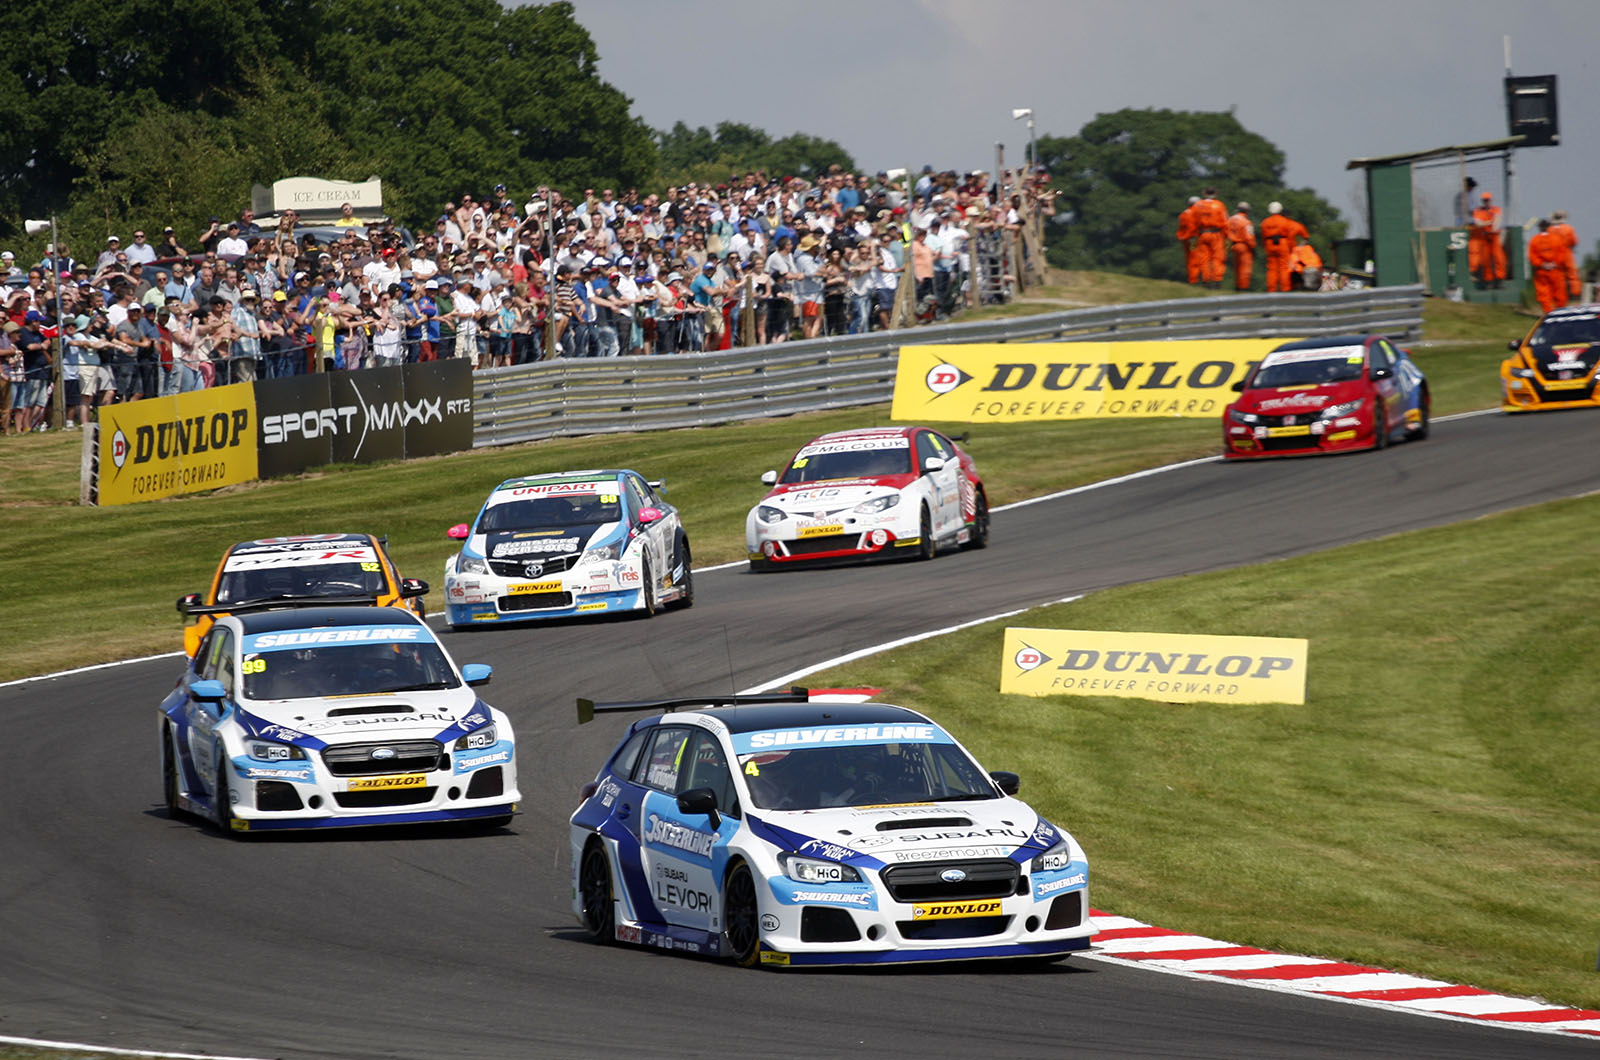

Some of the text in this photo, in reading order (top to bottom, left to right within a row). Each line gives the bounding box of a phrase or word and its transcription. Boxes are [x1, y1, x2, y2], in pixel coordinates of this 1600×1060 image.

[294, 190, 361, 203] ICE CREAM
[971, 399, 1217, 416] FOREVER FORWARD
[263, 396, 471, 444] SPORT MAXX RT2
[133, 408, 248, 464] DUNLOP
[818, 440, 906, 453] MG.CO.UK
[132, 462, 226, 494] FOREVER FORWARD
[512, 483, 598, 496] UNIPART
[796, 517, 840, 529] MG.CO.UK
[804, 526, 844, 535] DUNLOP
[232, 550, 369, 567] TYPE R
[360, 562, 381, 572] 52
[621, 570, 640, 581] reis
[516, 583, 561, 592] DUNLOP
[254, 628, 421, 649] SILVERLINE
[242, 658, 267, 675] 99
[1057, 649, 1294, 679] DUNLOP
[1051, 677, 1239, 696] FOREVER FORWARD
[342, 714, 456, 726] SUBARU
[468, 736, 484, 747] HiQ
[750, 723, 935, 748] SILVERLINE
[269, 749, 288, 758] HiQ
[745, 760, 760, 777] 4
[899, 828, 1029, 842] SUBARU
[820, 843, 855, 858] ADRIAN
[822, 850, 842, 861] FLUX
[896, 846, 1002, 862] Breezemount
[1044, 856, 1060, 867] HiQ
[664, 867, 688, 883] SUBARU
[817, 868, 840, 879] HiQ
[800, 892, 863, 903] SILVERLINE
[928, 903, 1000, 916] DUNLOP
